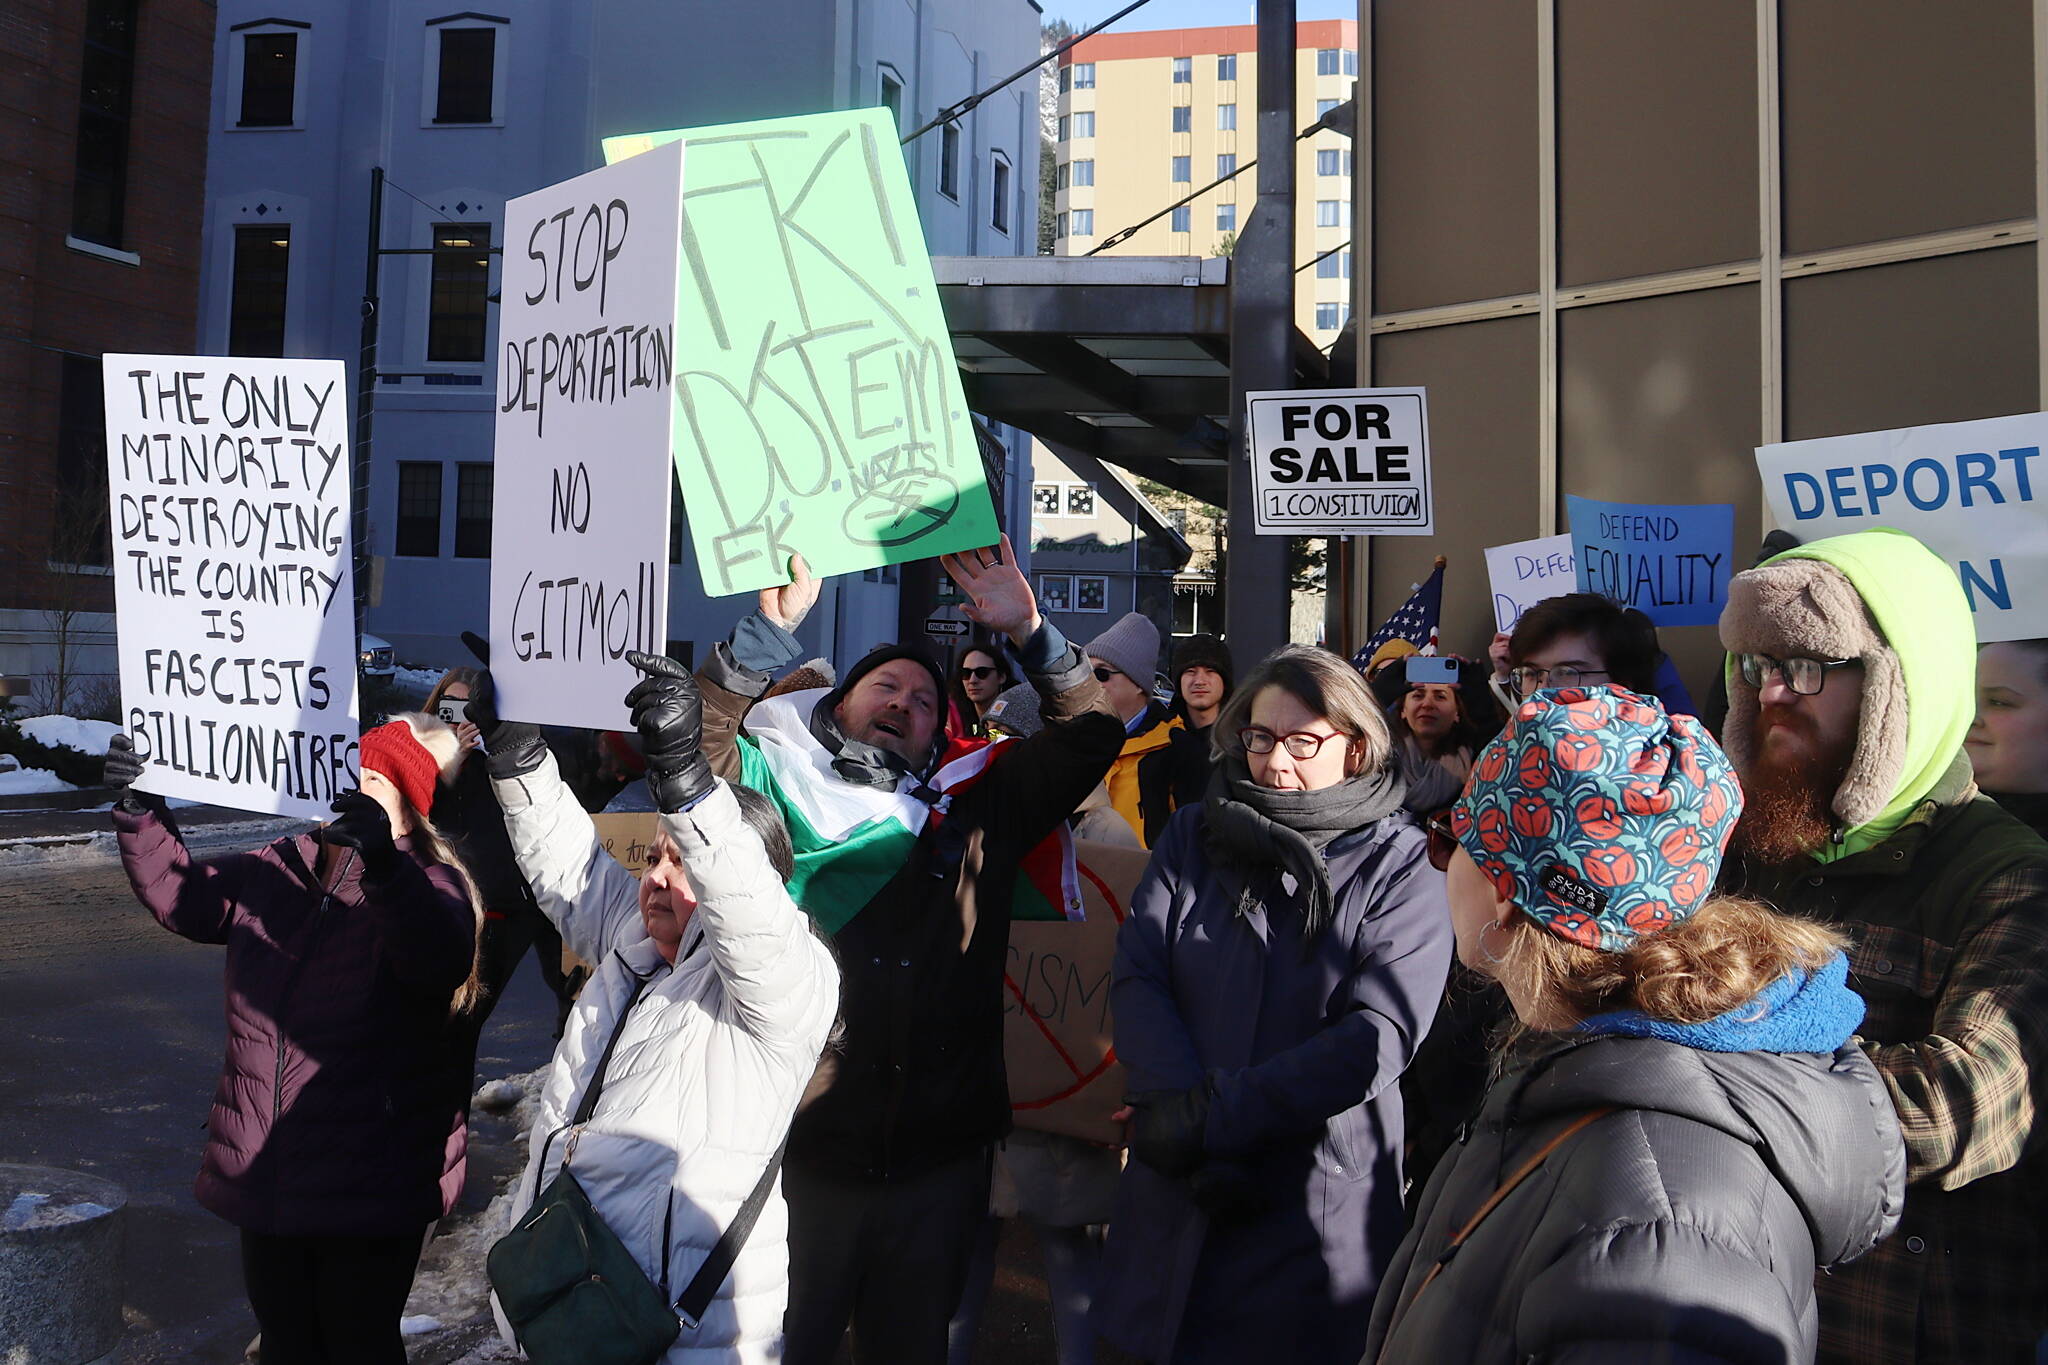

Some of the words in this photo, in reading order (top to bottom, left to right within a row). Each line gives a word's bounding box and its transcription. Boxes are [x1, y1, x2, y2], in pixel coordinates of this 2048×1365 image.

[525, 198, 629, 316] STOP
[128, 370, 210, 425] THE
[222, 373, 334, 435] ONLY
[501, 321, 674, 438] DEPORTATION
[1281, 404, 1392, 441] FOR
[121, 432, 342, 500] MINORITY
[849, 441, 939, 499] NAZIS
[1269, 446, 1411, 484] SALE
[1783, 446, 2040, 520] DEPORT
[120, 494, 342, 560] DESTROYING
[551, 462, 591, 534] NO
[1270, 495, 1284, 516] 1
[1287, 493, 1419, 517] CONSTITUTION
[1600, 512, 1679, 542] DEFEND
[127, 550, 186, 597] THE
[197, 558, 344, 618] COUNTRY
[1584, 545, 1722, 607] EQUALITY
[201, 609, 244, 643] IS
[929, 623, 943, 631] ONE
[145, 649, 330, 711] FASCISTS
[129, 708, 360, 802] BILLIONAIRES
[1553, 874, 1596, 903] SKIDA
